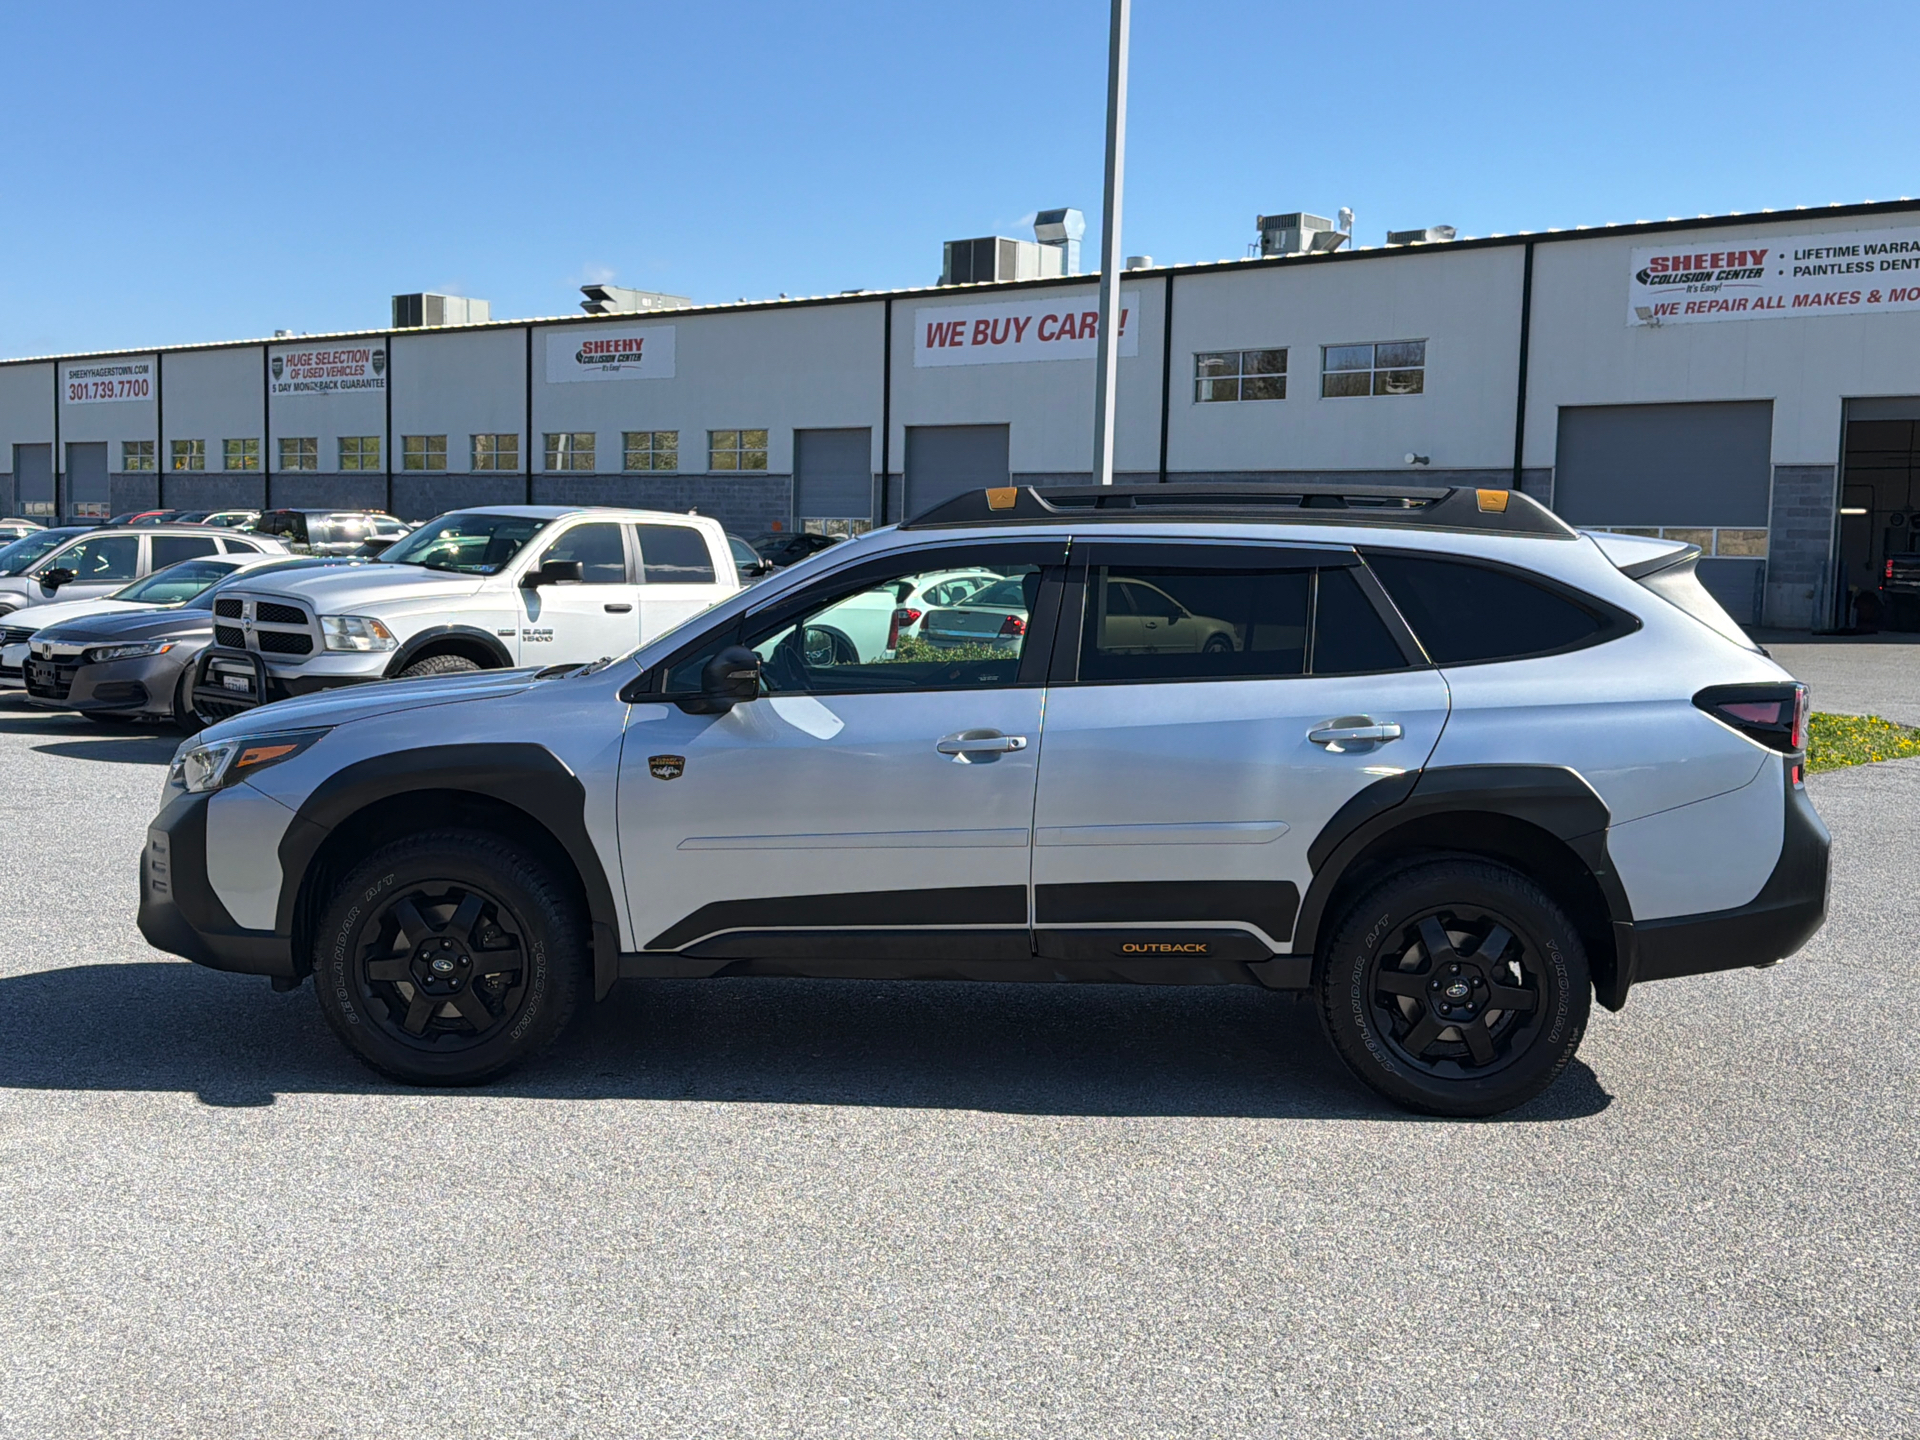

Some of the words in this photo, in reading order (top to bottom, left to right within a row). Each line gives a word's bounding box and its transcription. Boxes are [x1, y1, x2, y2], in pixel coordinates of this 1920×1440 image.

[1794, 245, 1860, 261] LIFETIME
[1864, 240, 1920, 256] WARRA
[1649, 249, 1769, 273] SHEEHY
[1793, 261, 1875, 277] PAINTLESS
[1880, 257, 1920, 272] DENT
[1649, 270, 1715, 286] COLLISION
[1715, 267, 1765, 281] CENTER
[1686, 284, 1699, 294] It's
[1700, 282, 1723, 294] Easy!
[1653, 302, 1681, 317] WE
[1684, 297, 1749, 315] REPAIR
[1751, 295, 1786, 311] ALL
[1791, 290, 1862, 308] MAKES
[1867, 289, 1882, 304] &
[1888, 286, 1920, 303] MO
[926, 320, 967, 348] WE
[971, 316, 1033, 346] BUY
[1037, 308, 1129, 342] CAR!
[582, 338, 645, 355] SHEEHY
[286, 352, 314, 368] HUGE
[314, 348, 370, 366] SELECTION
[583, 354, 617, 365] COLLISION
[617, 352, 643, 363] CENTER
[69, 364, 149, 380] SHEEHYHAGERSTOWN.COM
[290, 368, 302, 380] OF
[302, 367, 325, 379] USED
[326, 364, 365, 378] VEHICLES
[69, 378, 149, 401] 301.739.7700
[272, 383, 277, 393] 5
[278, 382, 292, 393] DAY
[340, 378, 385, 389] GUARANTEE
[1365, 914, 1389, 949] A/T
[333, 906, 361, 1025] GEOLANDAR
[365, 873, 395, 902] A/T
[1122, 943, 1207, 953] OUTBACK
[510, 940, 547, 1040] YOKOHAMA
[1546, 939, 1570, 1044] YOKOHAMA
[1351, 955, 1395, 1072] GEOLANDAR
